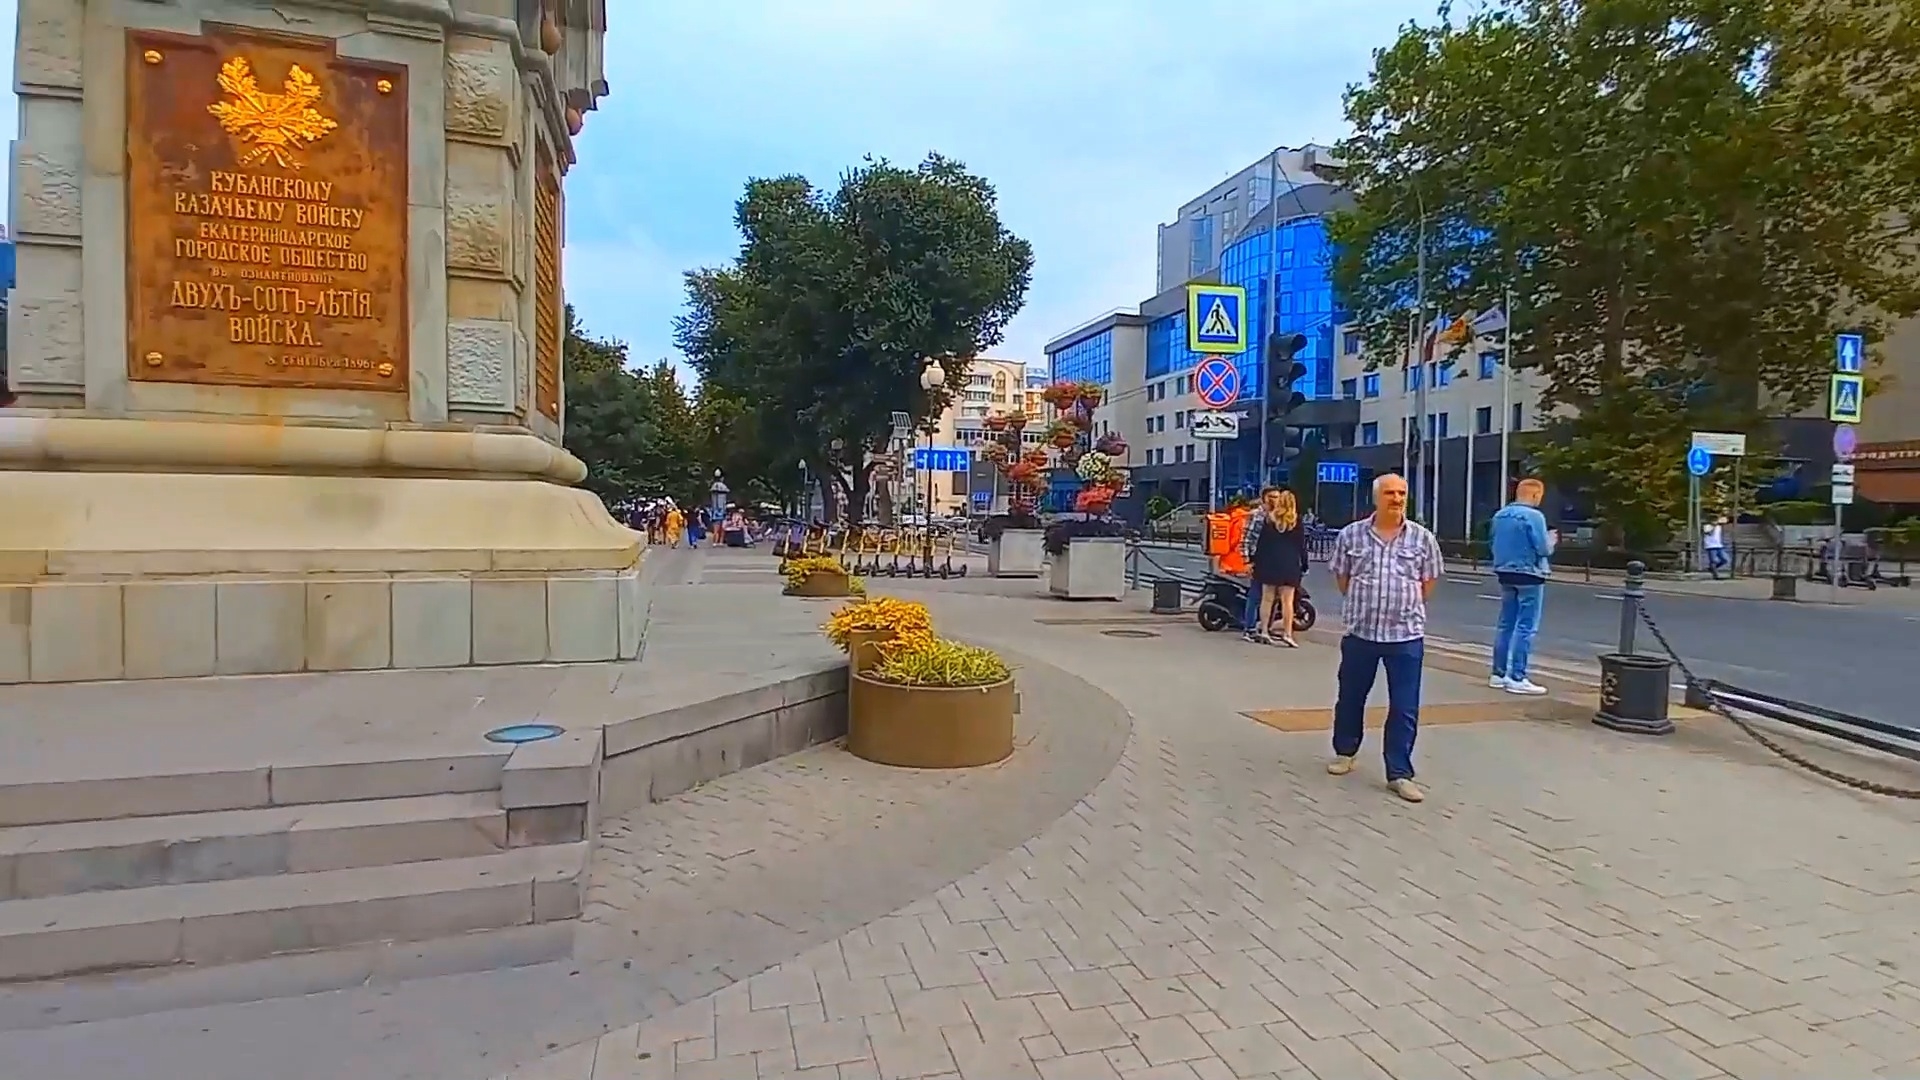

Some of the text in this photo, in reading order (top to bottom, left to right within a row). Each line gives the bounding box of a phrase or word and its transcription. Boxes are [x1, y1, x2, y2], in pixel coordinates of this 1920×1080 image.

[211, 171, 332, 202] КУБАНСКОМУ
[175, 191, 363, 229] КАЗАЧЬЕМУ ВОЙСКУ
[200, 222, 352, 249] ЕКАТЕРИНОДАРСКОЕ
[175, 238, 367, 270] ГОРОДСКОЕ ОБЩЕСТВО
